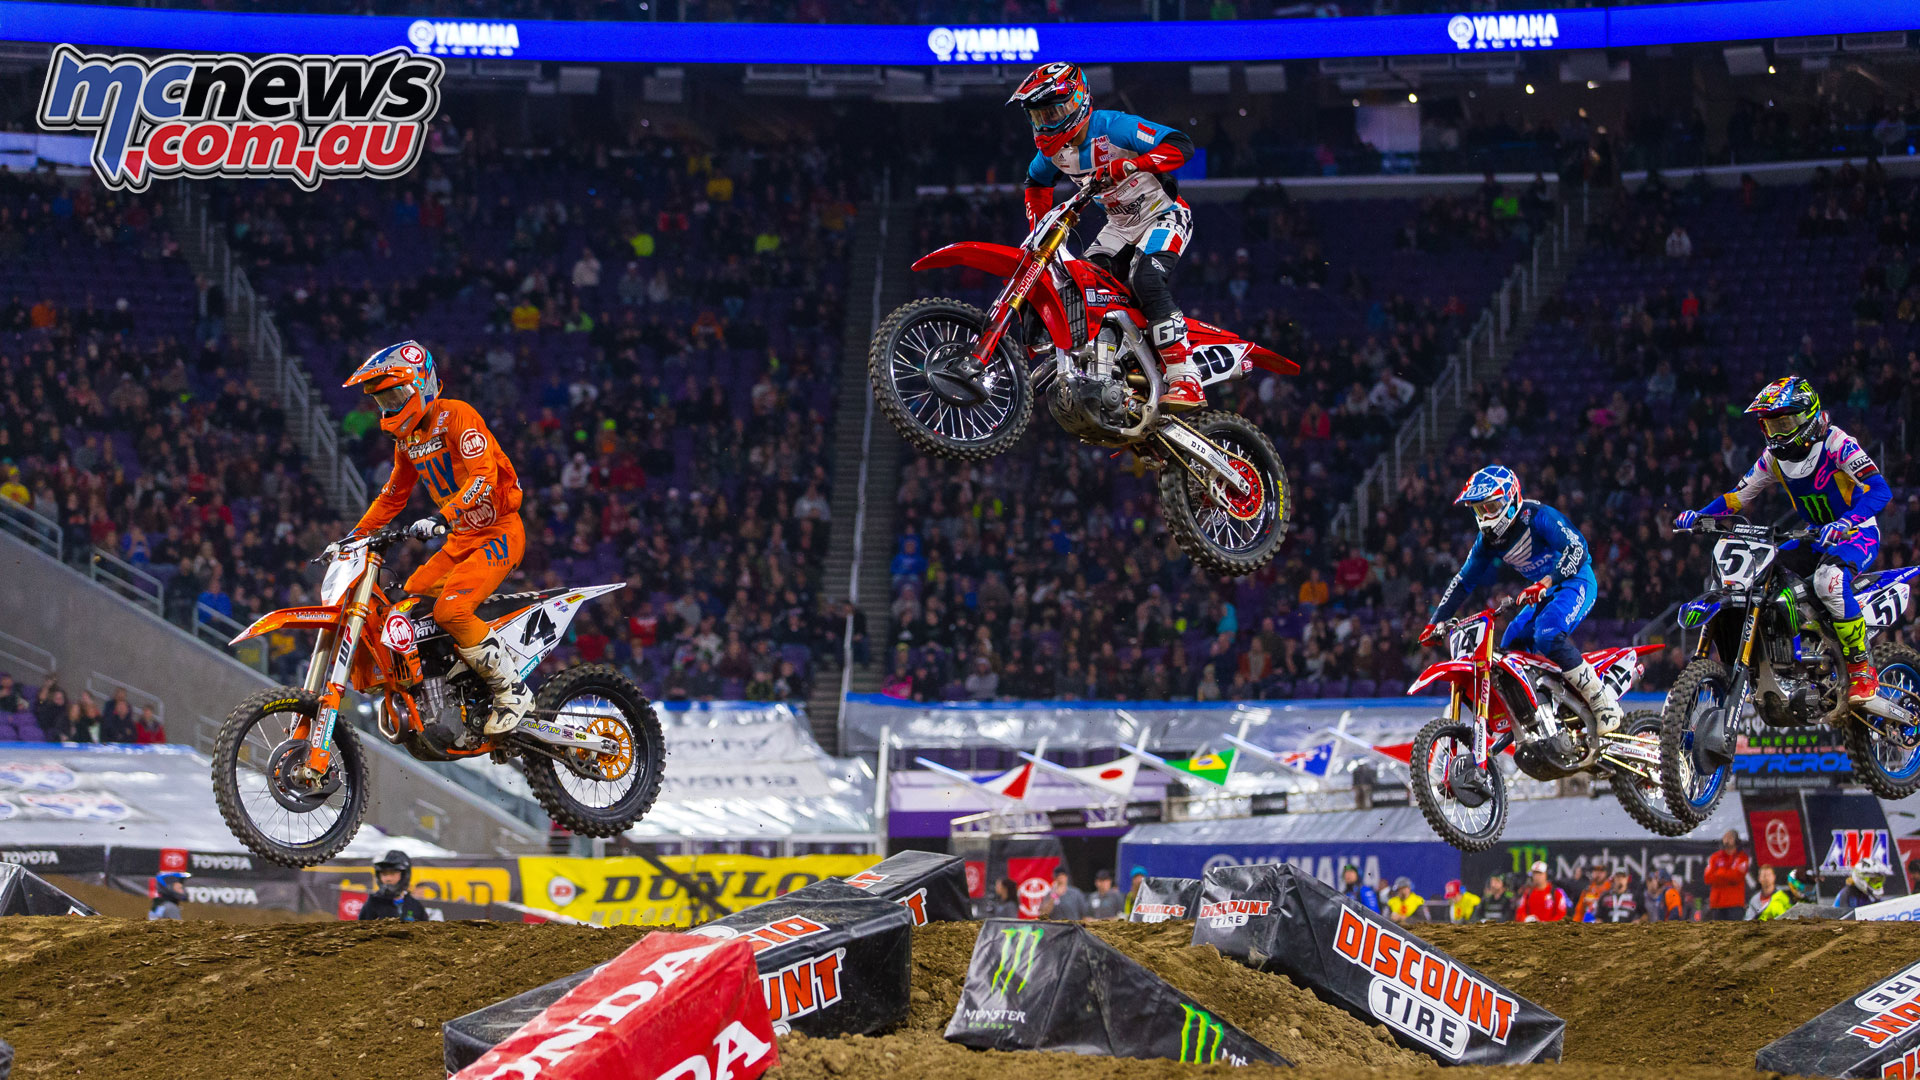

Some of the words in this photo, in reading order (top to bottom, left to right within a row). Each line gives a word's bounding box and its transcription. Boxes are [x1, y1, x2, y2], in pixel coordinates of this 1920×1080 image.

[434, 22, 519, 48] YAMAHA
[953, 28, 1039, 52] YAMAHA
[1472, 14, 1559, 40] YAMAHA
[1190, 440, 1206, 454] DID
[519, 606, 557, 647] 4
[1452, 624, 1479, 660] 14
[1603, 664, 1633, 697] 14
[263, 698, 300, 711] DUNLOP
[1733, 679, 1748, 731] DUNLOP
[324, 711, 337, 742] MOTOREX
[1477, 723, 1486, 754] DUNLOP
[2, 851, 59, 865] TOYOTA
[191, 854, 252, 870] TOYOTA
[187, 886, 259, 904] TOYOTA
[596, 871, 838, 904] DUNLO
[1135, 904, 1185, 917] AMERICA'S
[1201, 901, 1271, 917] DISCOUNT
[1215, 915, 1243, 926] TIRE
[1335, 907, 1515, 1042] DISCOUNT
[963, 1008, 1026, 1024] MONSTER
[1381, 985, 1458, 1049] TIRE
